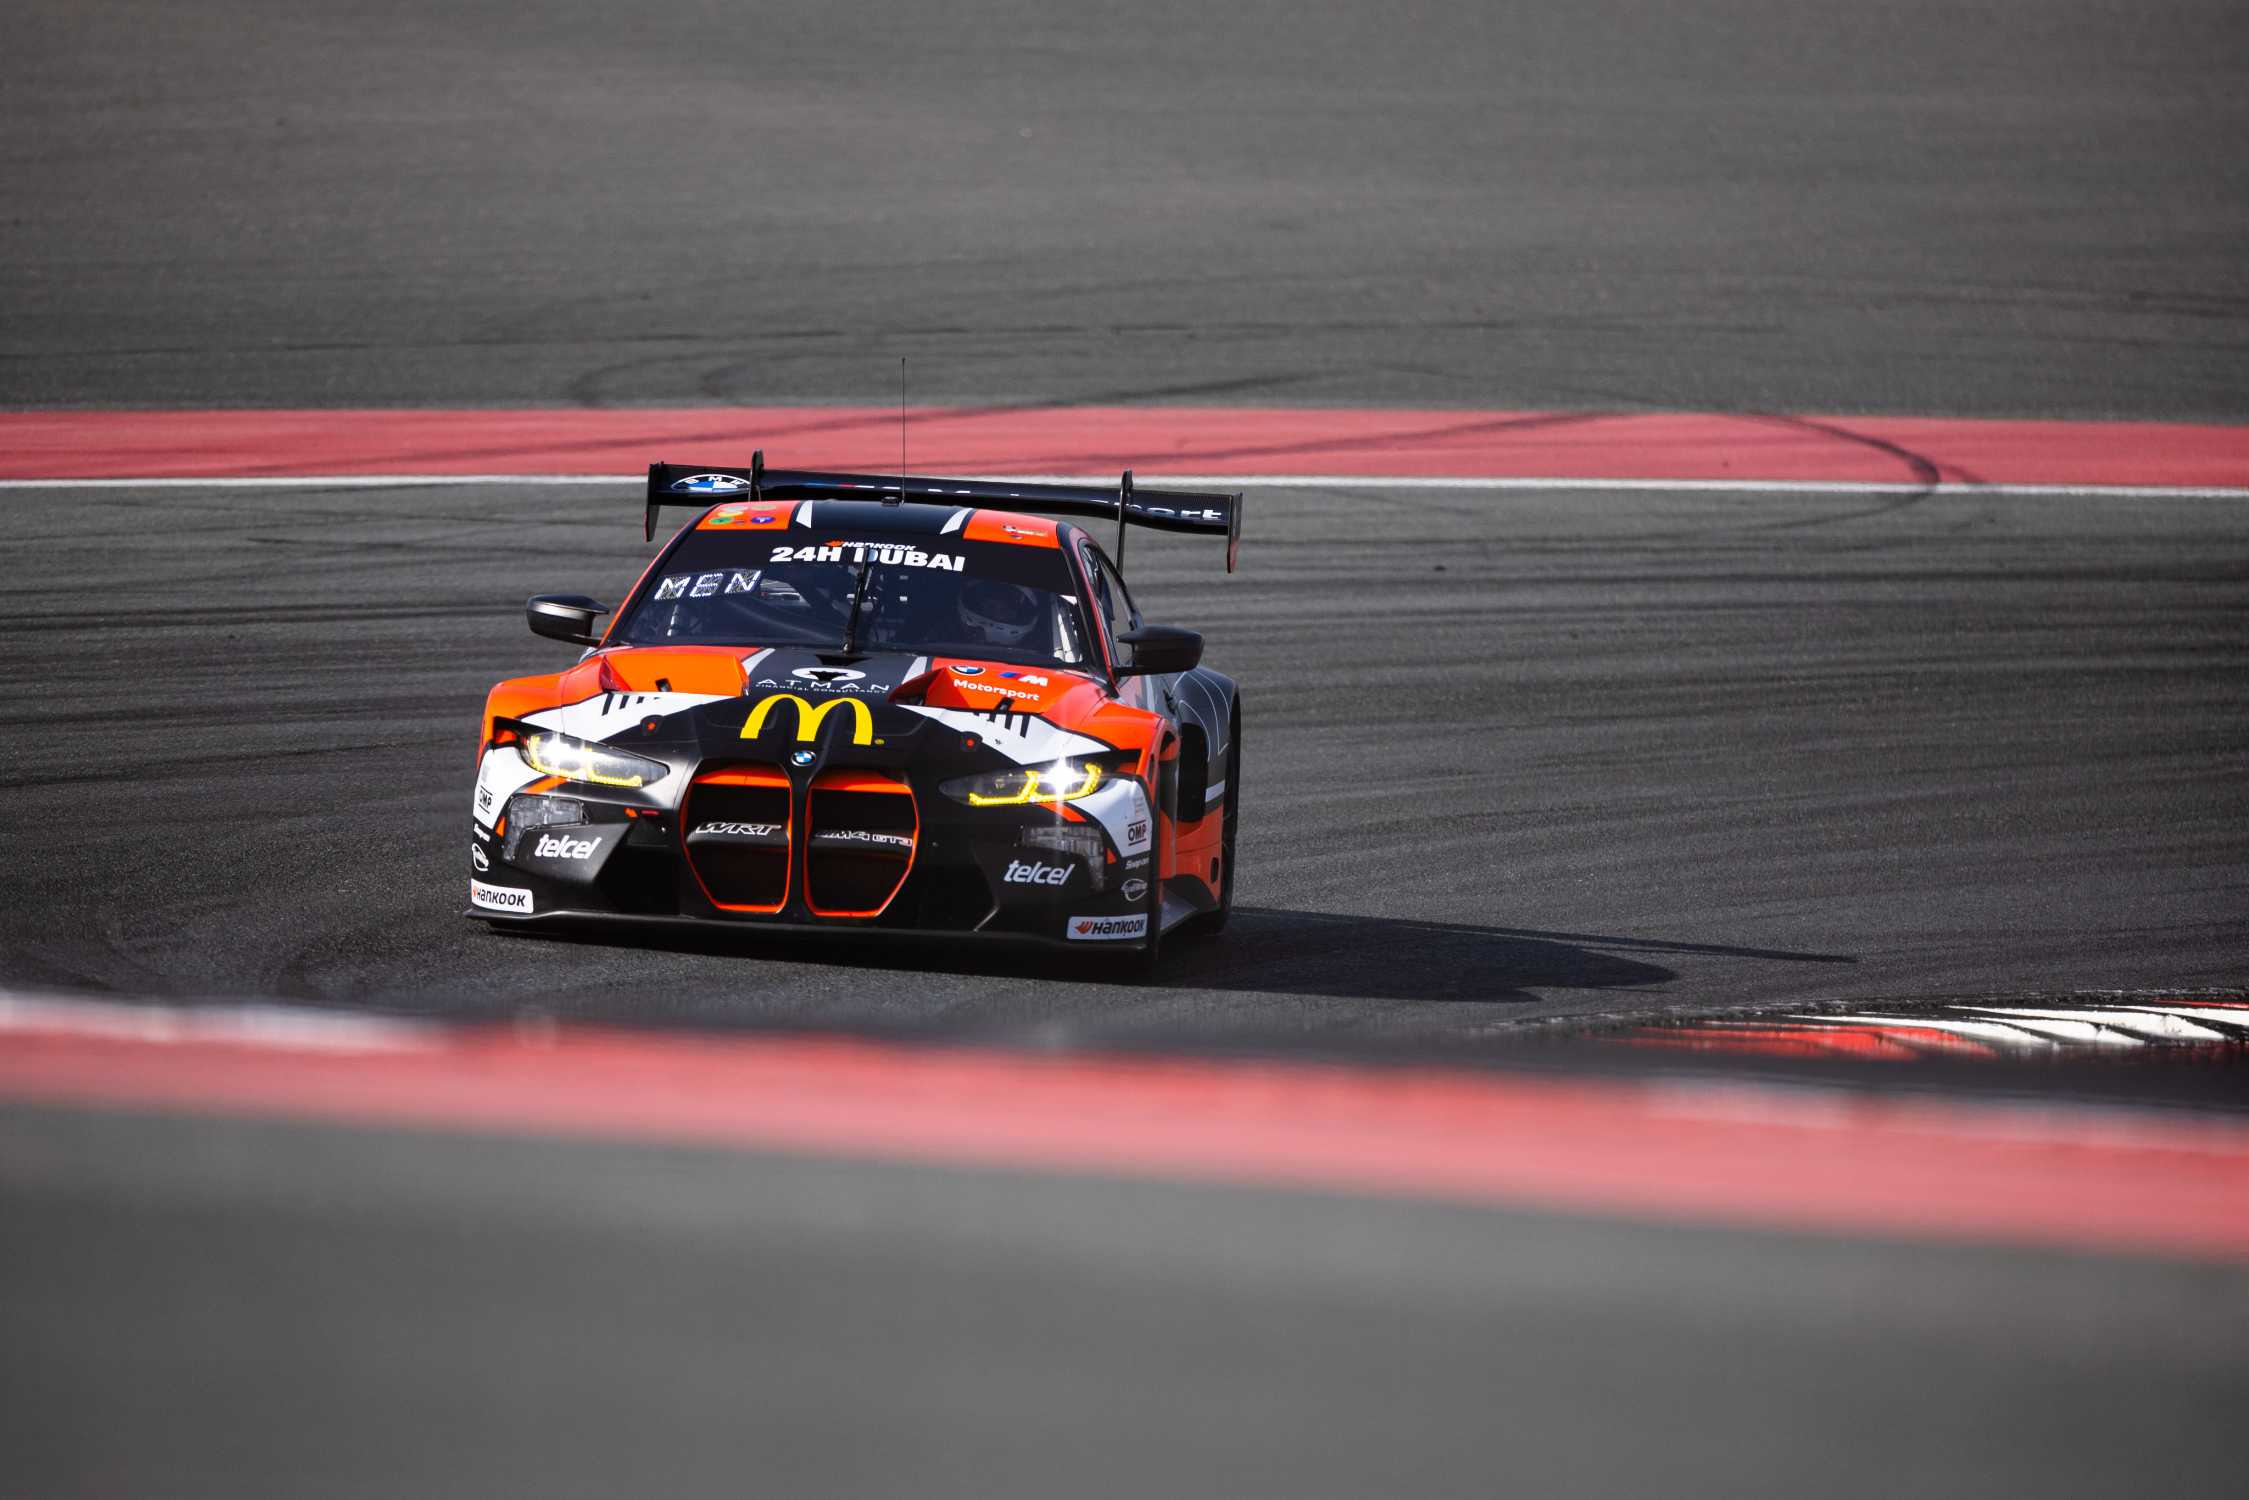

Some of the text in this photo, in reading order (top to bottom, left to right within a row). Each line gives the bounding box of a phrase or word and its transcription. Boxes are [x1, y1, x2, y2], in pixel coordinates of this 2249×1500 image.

[770, 546, 966, 572] 24H DUBAI
[757, 678, 890, 692] ATMAN
[953, 679, 1040, 701] Motorsport
[696, 822, 782, 836] WRT
[1128, 823, 1147, 842] OMP
[534, 833, 602, 860] telcel
[1003, 859, 1076, 886] telcel
